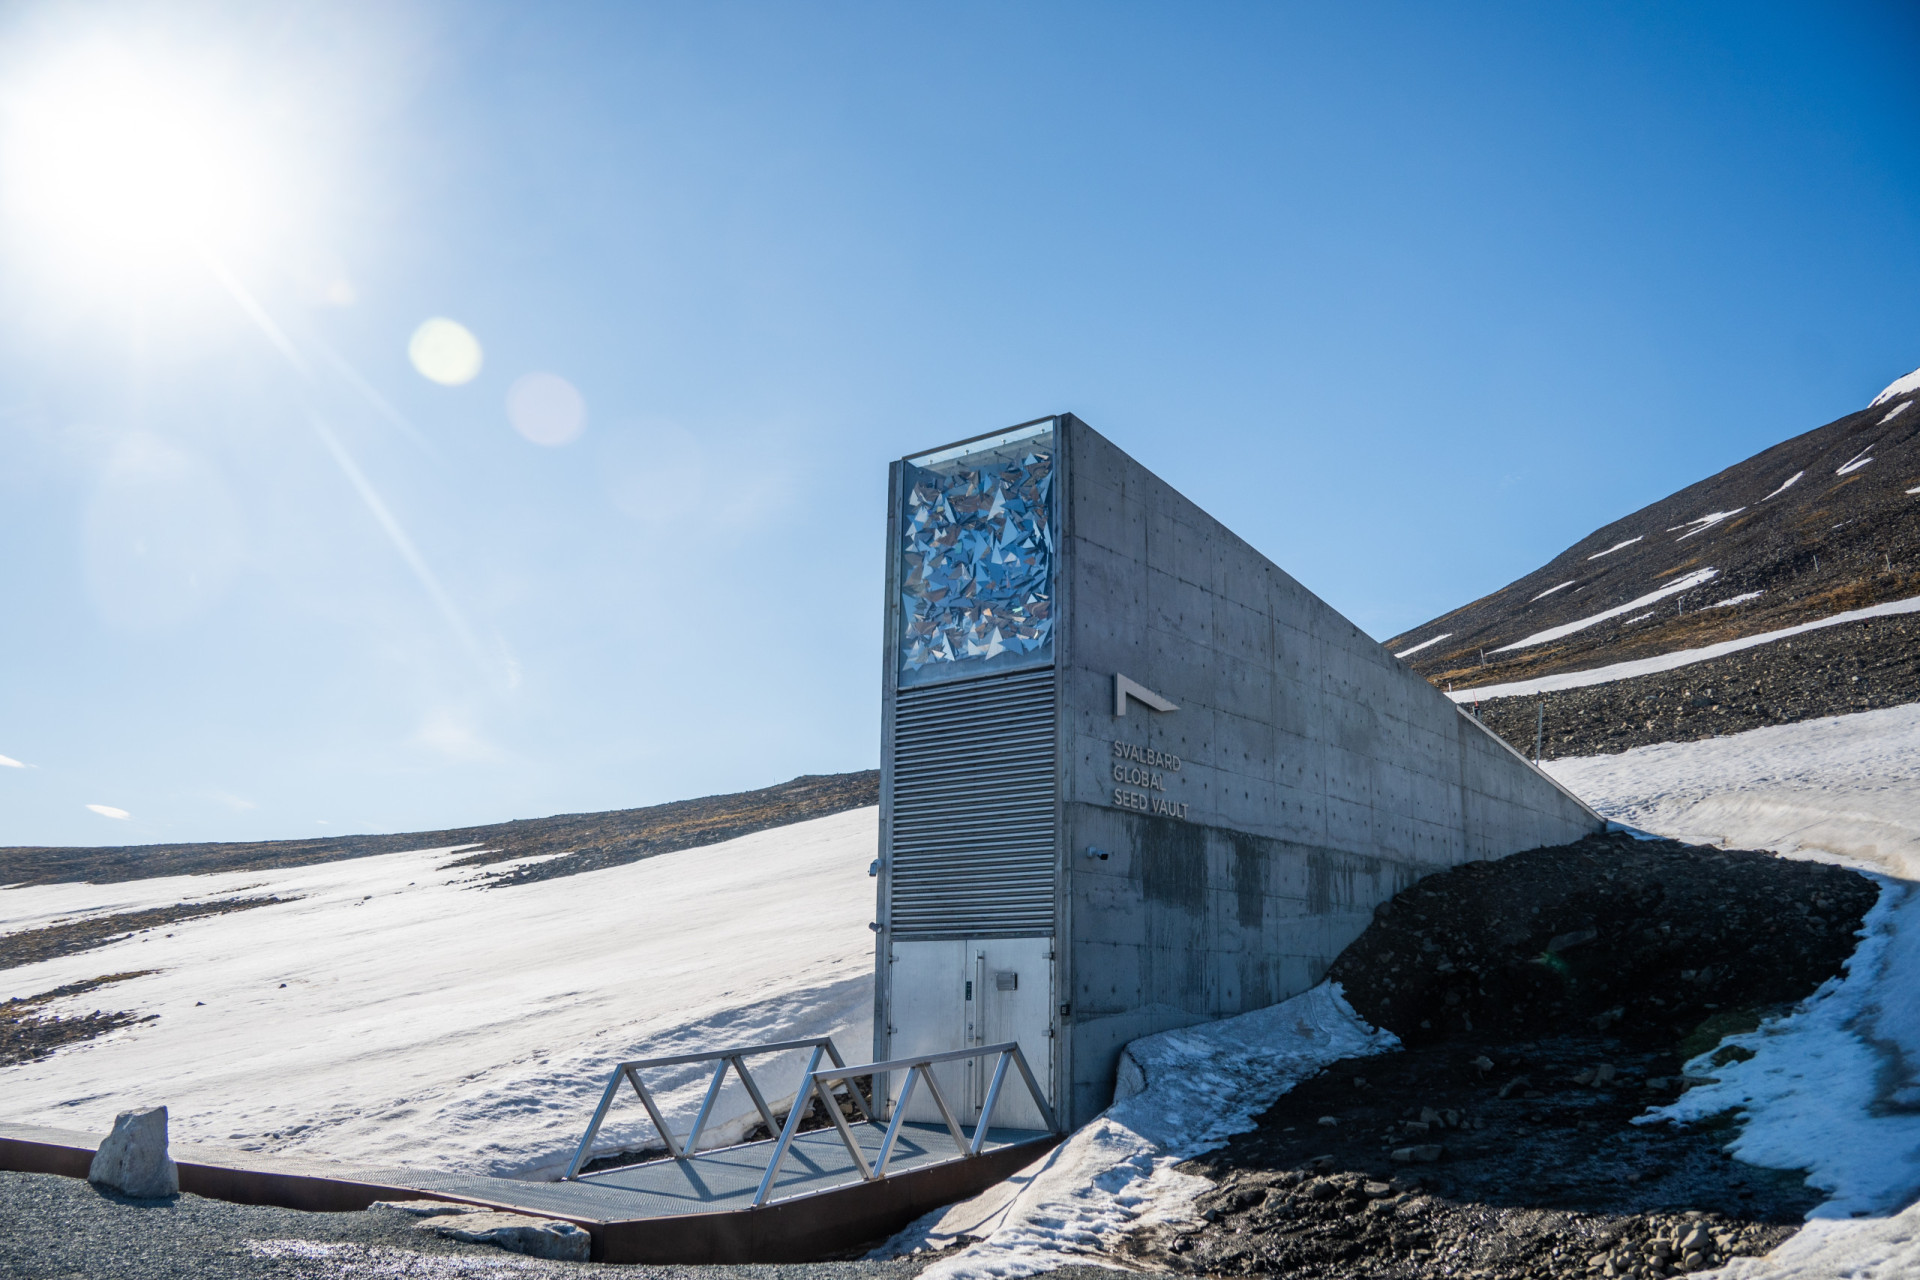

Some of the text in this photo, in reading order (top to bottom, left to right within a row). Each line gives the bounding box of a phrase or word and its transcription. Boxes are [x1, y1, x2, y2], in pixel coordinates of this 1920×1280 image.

[1114, 740, 1182, 771] SVALBARD
[1113, 765, 1167, 791] GLOBAL
[1114, 788, 1189, 819] SEED VAULT
